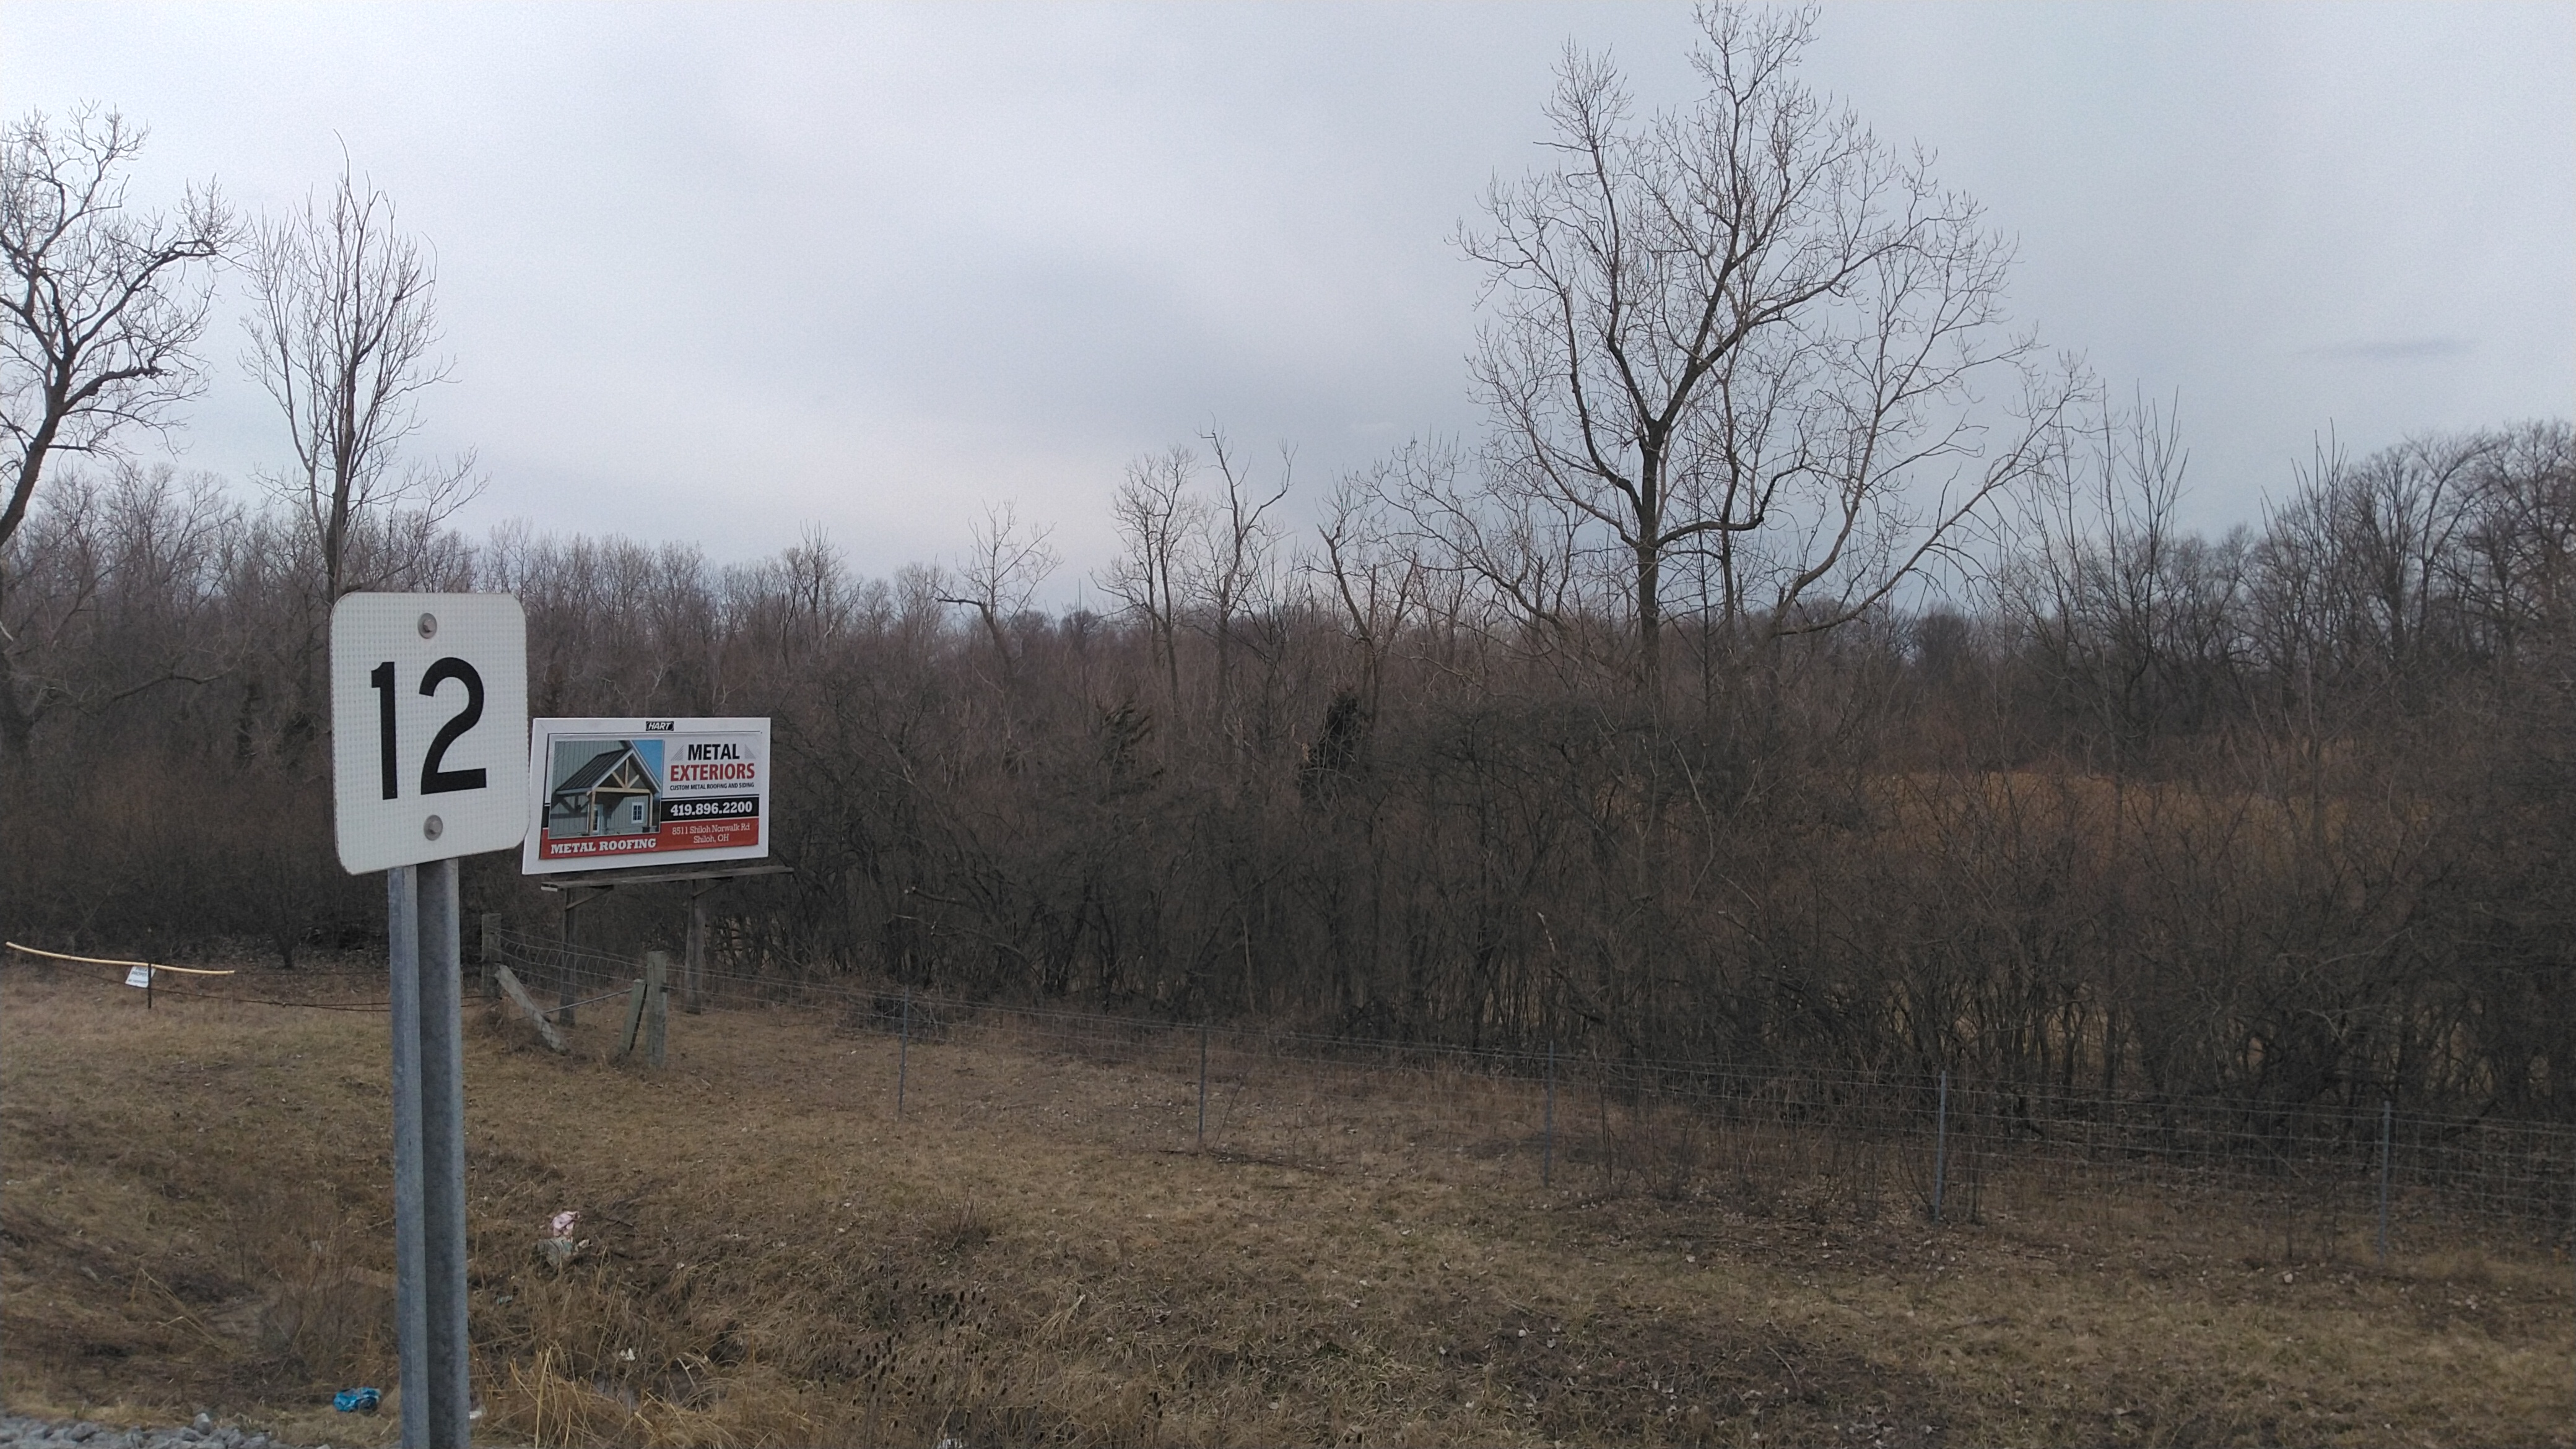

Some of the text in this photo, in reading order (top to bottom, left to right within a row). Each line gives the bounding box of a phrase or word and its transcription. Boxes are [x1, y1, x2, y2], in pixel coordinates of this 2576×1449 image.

[371, 656, 487, 801] 12
[648, 723, 671, 731] HART
[688, 744, 740, 761] METAL
[671, 763, 755, 781] EXTERIORS
[670, 801, 752, 816] 419.896.2200
[672, 823, 750, 835] 8511 Shiloh Norwalk Rd
[550, 838, 656, 855] METAL ROOFING
[694, 835, 729, 844] Shiloh, OH
